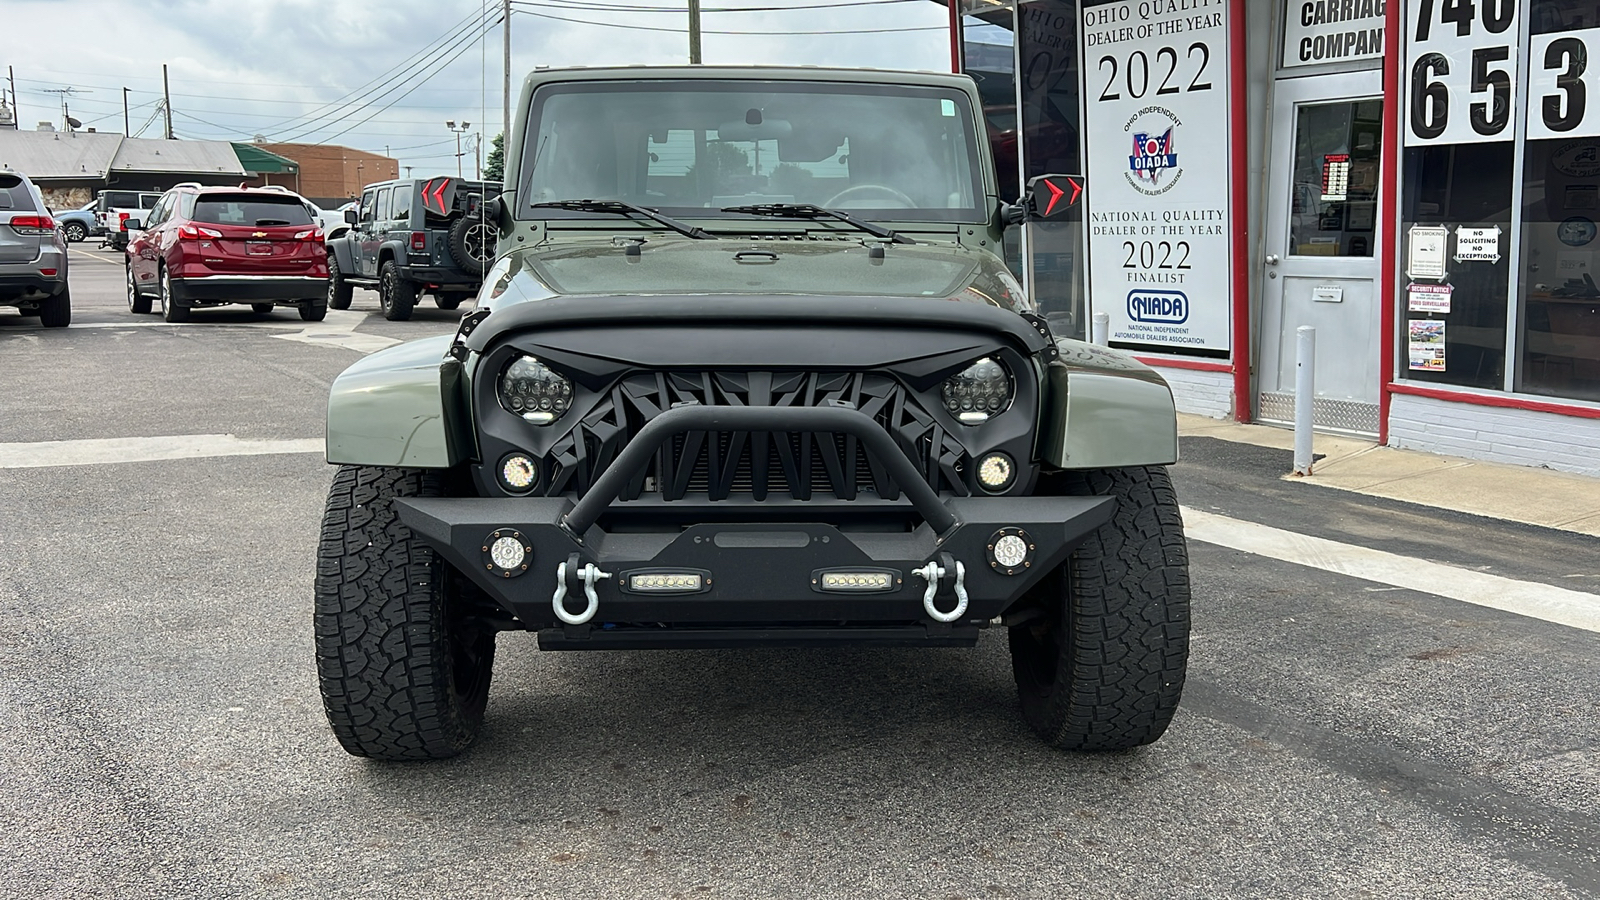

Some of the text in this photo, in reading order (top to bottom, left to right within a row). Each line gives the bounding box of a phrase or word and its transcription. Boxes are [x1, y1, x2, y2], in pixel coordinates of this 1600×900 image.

[1085, 0, 1222, 27] OHIO QUALI
[1301, 0, 1386, 27] CARRIAG
[1087, 12, 1222, 47] DEALER OF THE YEAR
[1299, 28, 1386, 61] COMPAN
[1098, 42, 1212, 102] 2022
[1124, 106, 1183, 132] OHIO INDEPENDENT
[1134, 155, 1169, 169] OIADA
[1091, 210, 1224, 223] NATIONAL QUALITY
[1093, 225, 1223, 236] DEALER OF THE YEAR
[1122, 240, 1192, 270] 2022
[1127, 272, 1186, 283] FINALIST
[1411, 285, 1432, 293] SECURITY
[1131, 297, 1183, 317] NIADA
[1114, 332, 1205, 344] AUTOMOBILE DEALERS ASSOCIATION
[1127, 324, 1189, 334] NATIONAL INDEPENDENT
